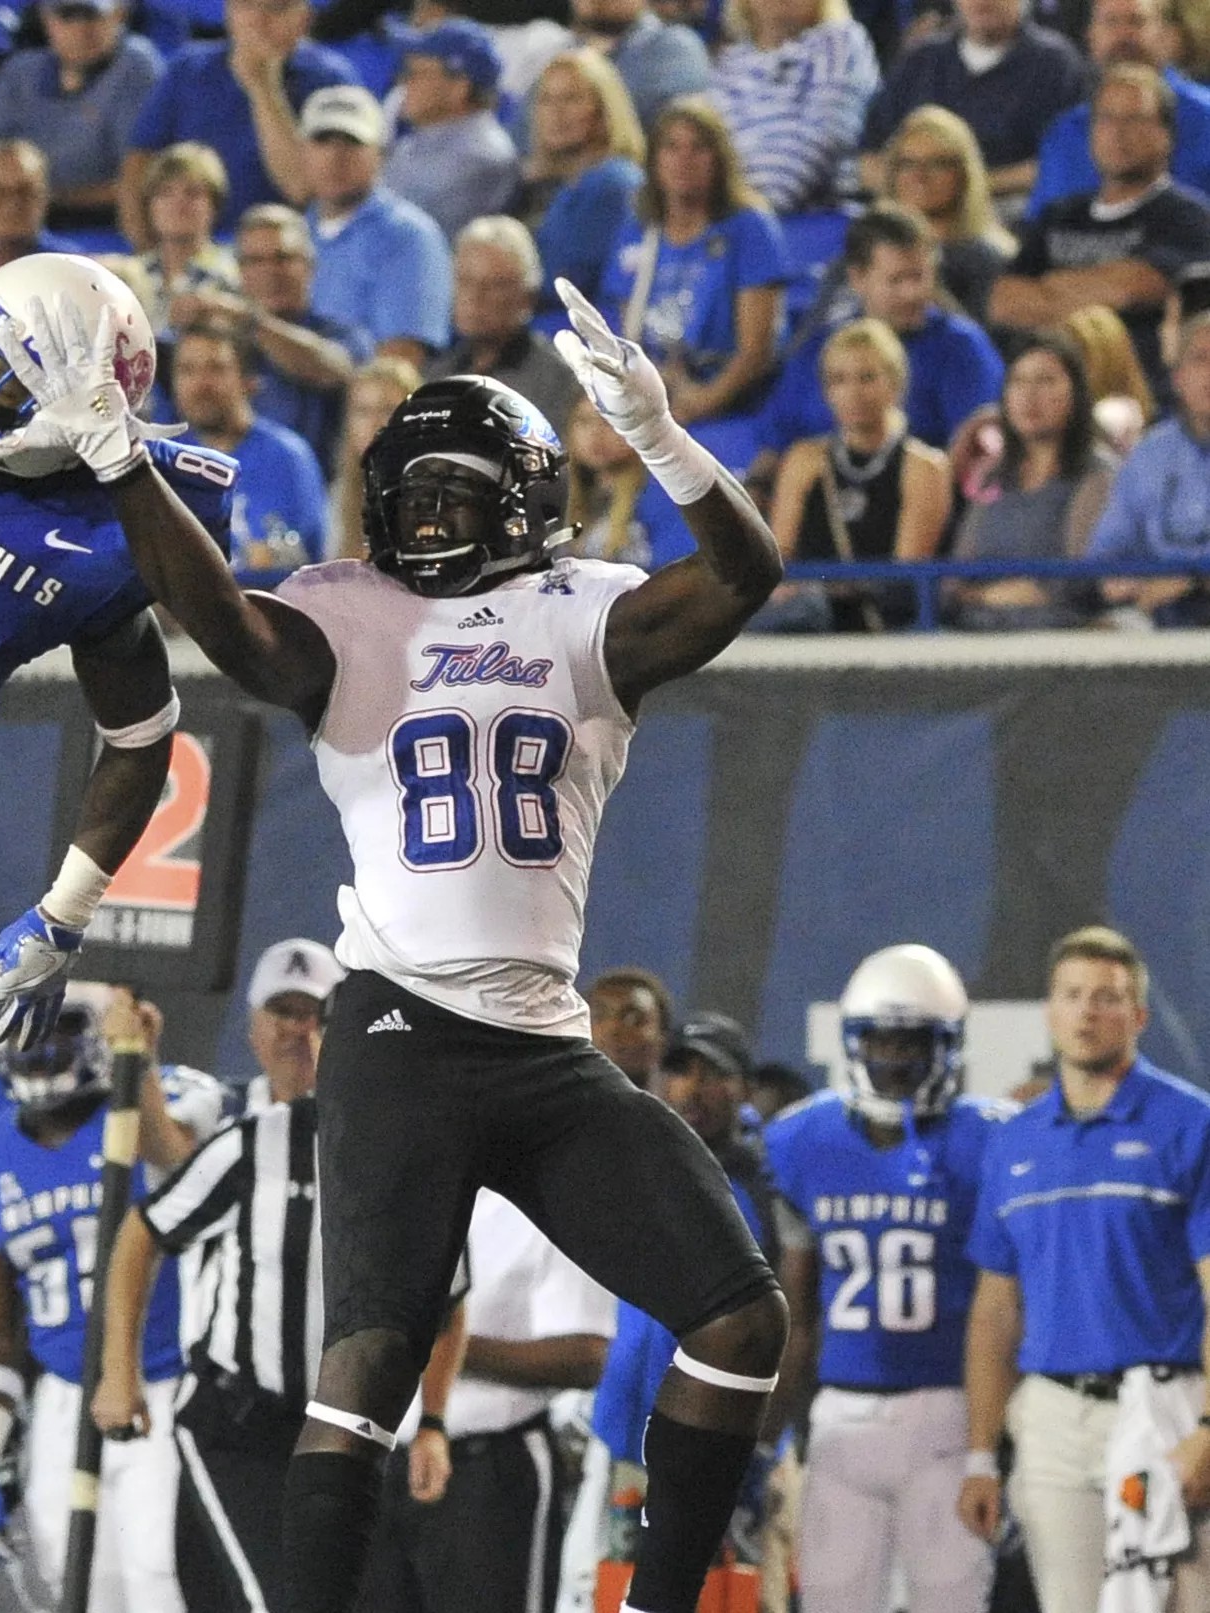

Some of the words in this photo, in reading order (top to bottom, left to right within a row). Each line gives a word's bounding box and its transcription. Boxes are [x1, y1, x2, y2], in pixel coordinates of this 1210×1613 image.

[174, 450, 236, 488] 8
[410, 641, 554, 692] Tulsa
[97, 730, 211, 912] 2
[387, 706, 575, 873] 88
[822, 1229, 936, 1333] 26
